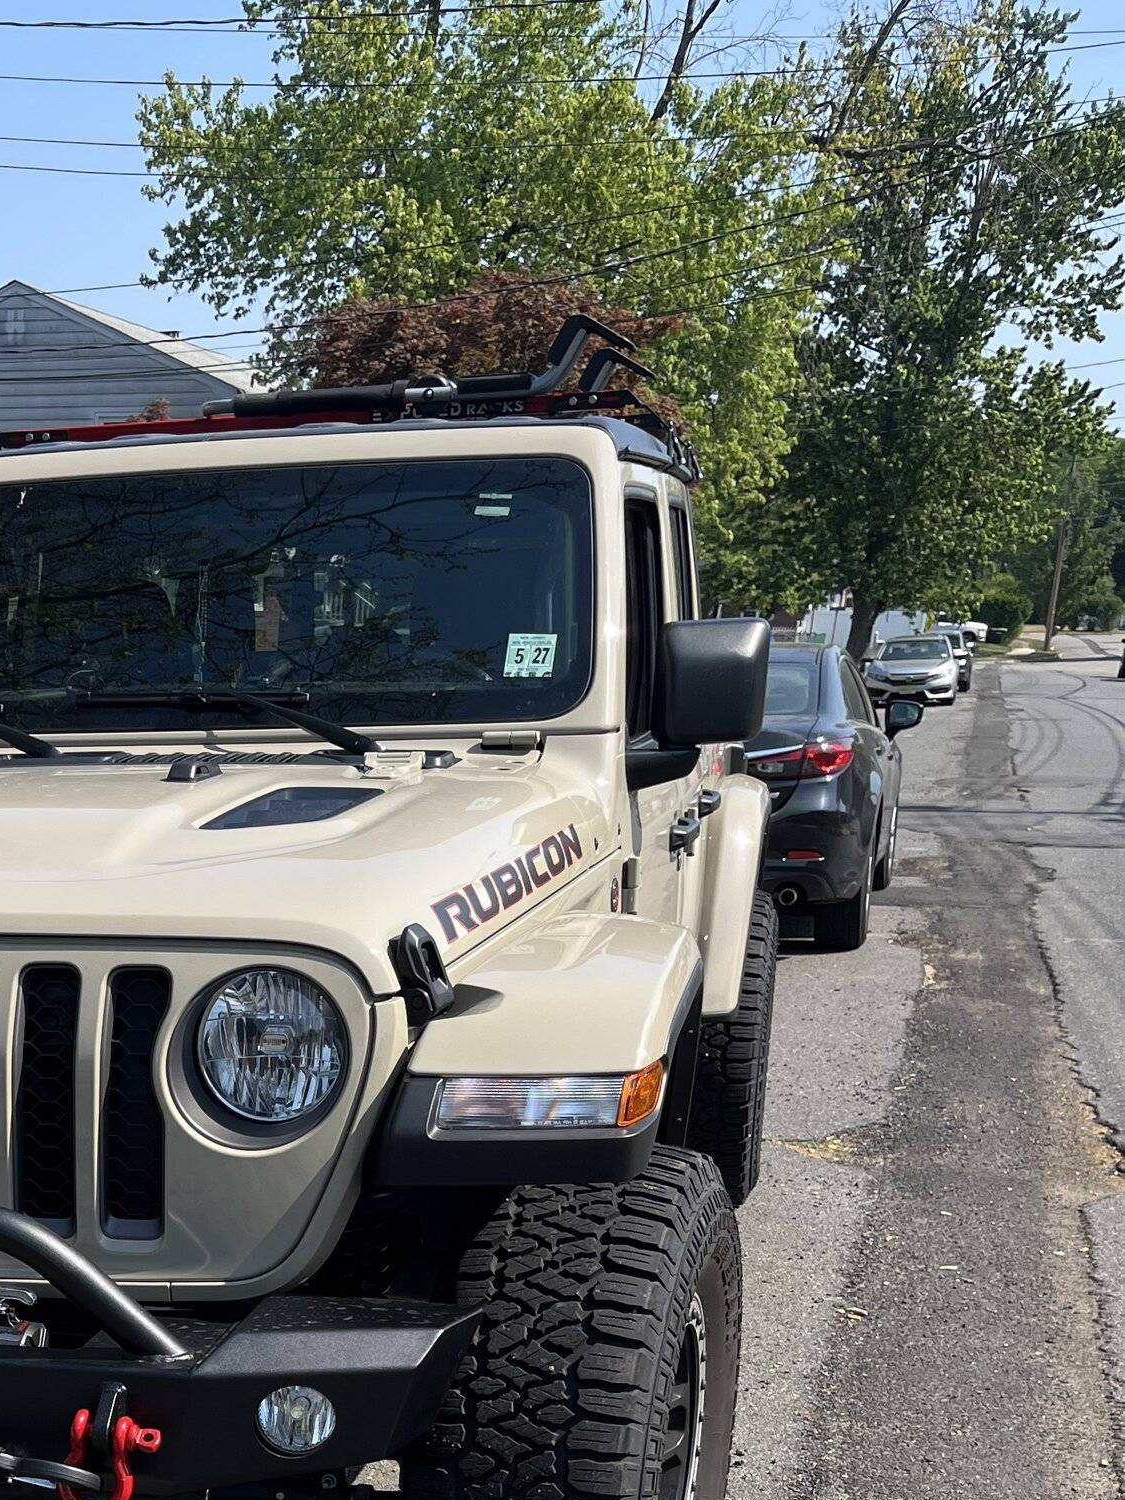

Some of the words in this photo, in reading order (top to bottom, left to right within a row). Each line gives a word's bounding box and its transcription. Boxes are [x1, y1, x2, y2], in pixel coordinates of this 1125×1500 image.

[467, 401, 524, 415] RAKS
[515, 647, 525, 664] 5
[531, 647, 551, 664] 27
[430, 823, 583, 944] RUBICON
